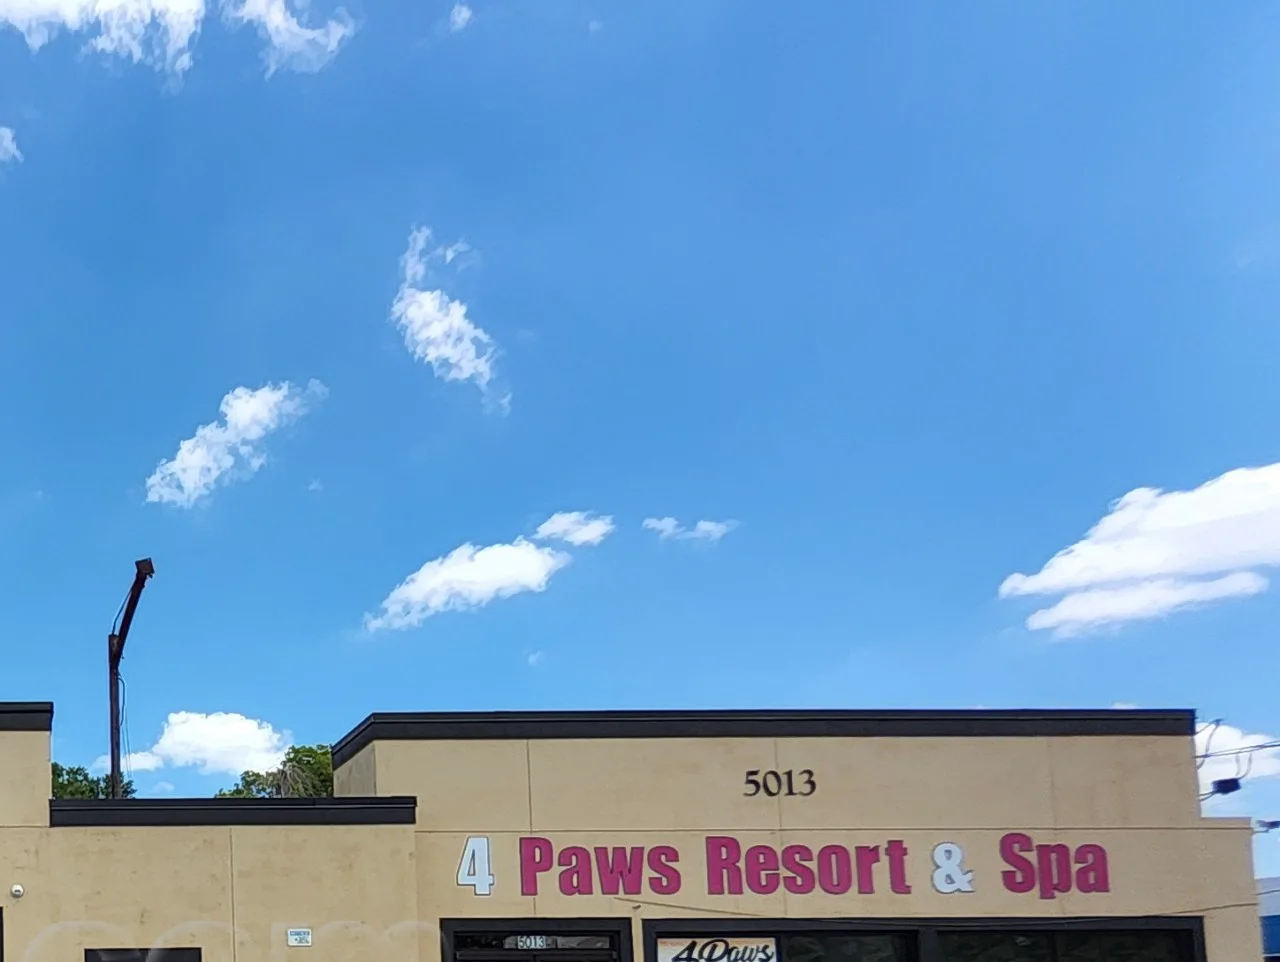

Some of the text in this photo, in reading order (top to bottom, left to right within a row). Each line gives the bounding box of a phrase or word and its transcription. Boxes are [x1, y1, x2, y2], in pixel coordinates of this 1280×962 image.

[743, 769, 817, 797] 5013
[456, 832, 1110, 900] 4 Paws Resort & Spa
[518, 935, 545, 949] 5013
